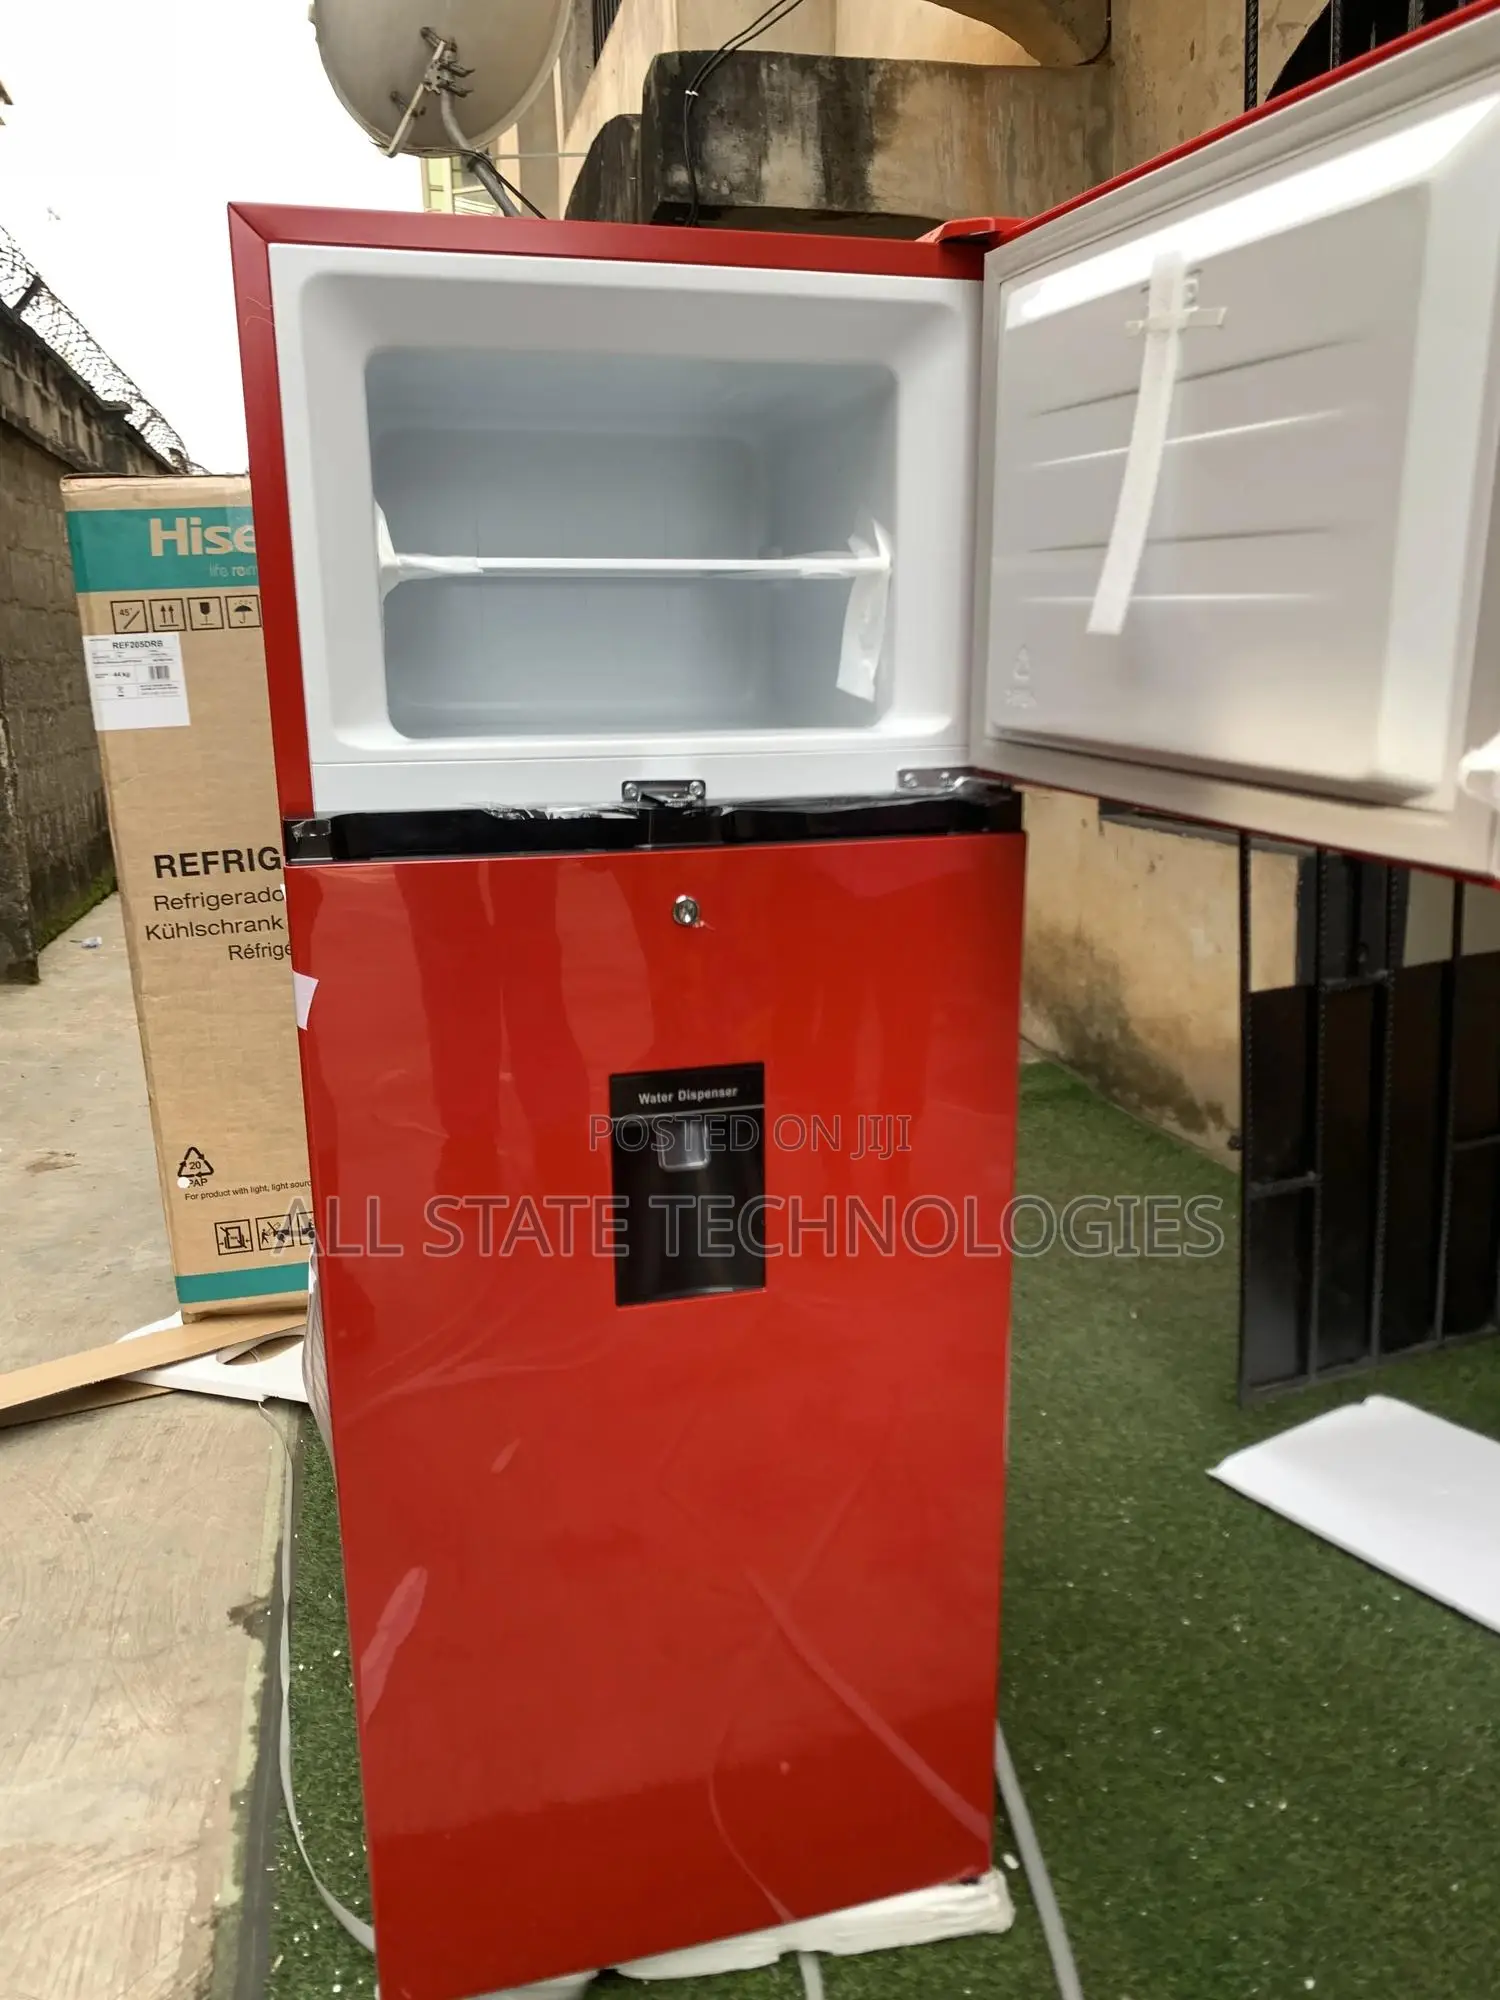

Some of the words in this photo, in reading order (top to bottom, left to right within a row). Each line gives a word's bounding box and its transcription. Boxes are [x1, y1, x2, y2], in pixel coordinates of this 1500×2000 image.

[150, 517, 257, 556] Hise
[154, 846, 282, 878] REFRIG
[154, 886, 284, 911] Refrigerado
[145, 915, 284, 940] Kühlschrank
[638, 1091, 674, 1105] Water
[678, 1086, 739, 1102] Dispenser
[189, 1160, 201, 1170] 20
[185, 1192, 198, 1201] For
[200, 1188, 231, 1200] product
[232, 1186, 249, 1196] with
[250, 1183, 270, 1195] light,
[271, 1181, 289, 1191] light
